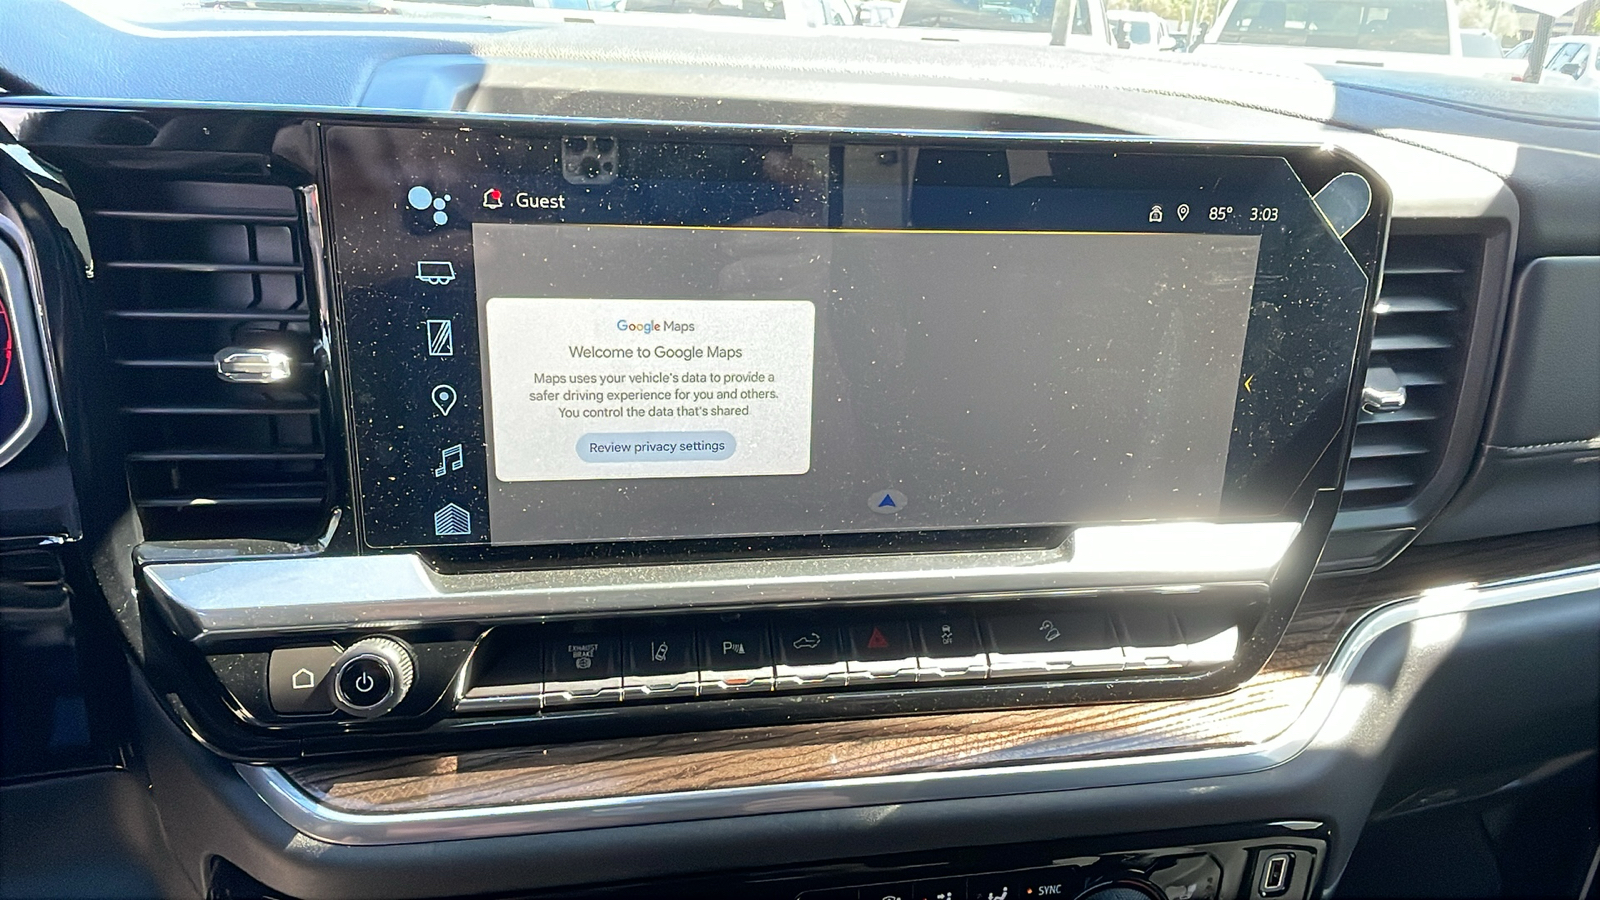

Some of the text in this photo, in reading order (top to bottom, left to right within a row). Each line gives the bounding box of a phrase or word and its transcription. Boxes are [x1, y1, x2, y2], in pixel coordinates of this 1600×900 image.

[516, 192, 566, 209] Guest
[1250, 207, 1279, 222] 3:03
[616, 319, 695, 334] Google Maps
[568, 345, 743, 361] Welcome to Google Maps
[534, 371, 775, 387] Maps uses your vehicle's data to provide a
[529, 388, 779, 403] safer driving experience for you and others.
[558, 405, 749, 418] You control the data that's shared
[589, 440, 725, 455] Review privacy settings
[567, 643, 599, 653] EXHAUST
[572, 650, 594, 659] BRAKE
[1038, 884, 1062, 896] SYNC
